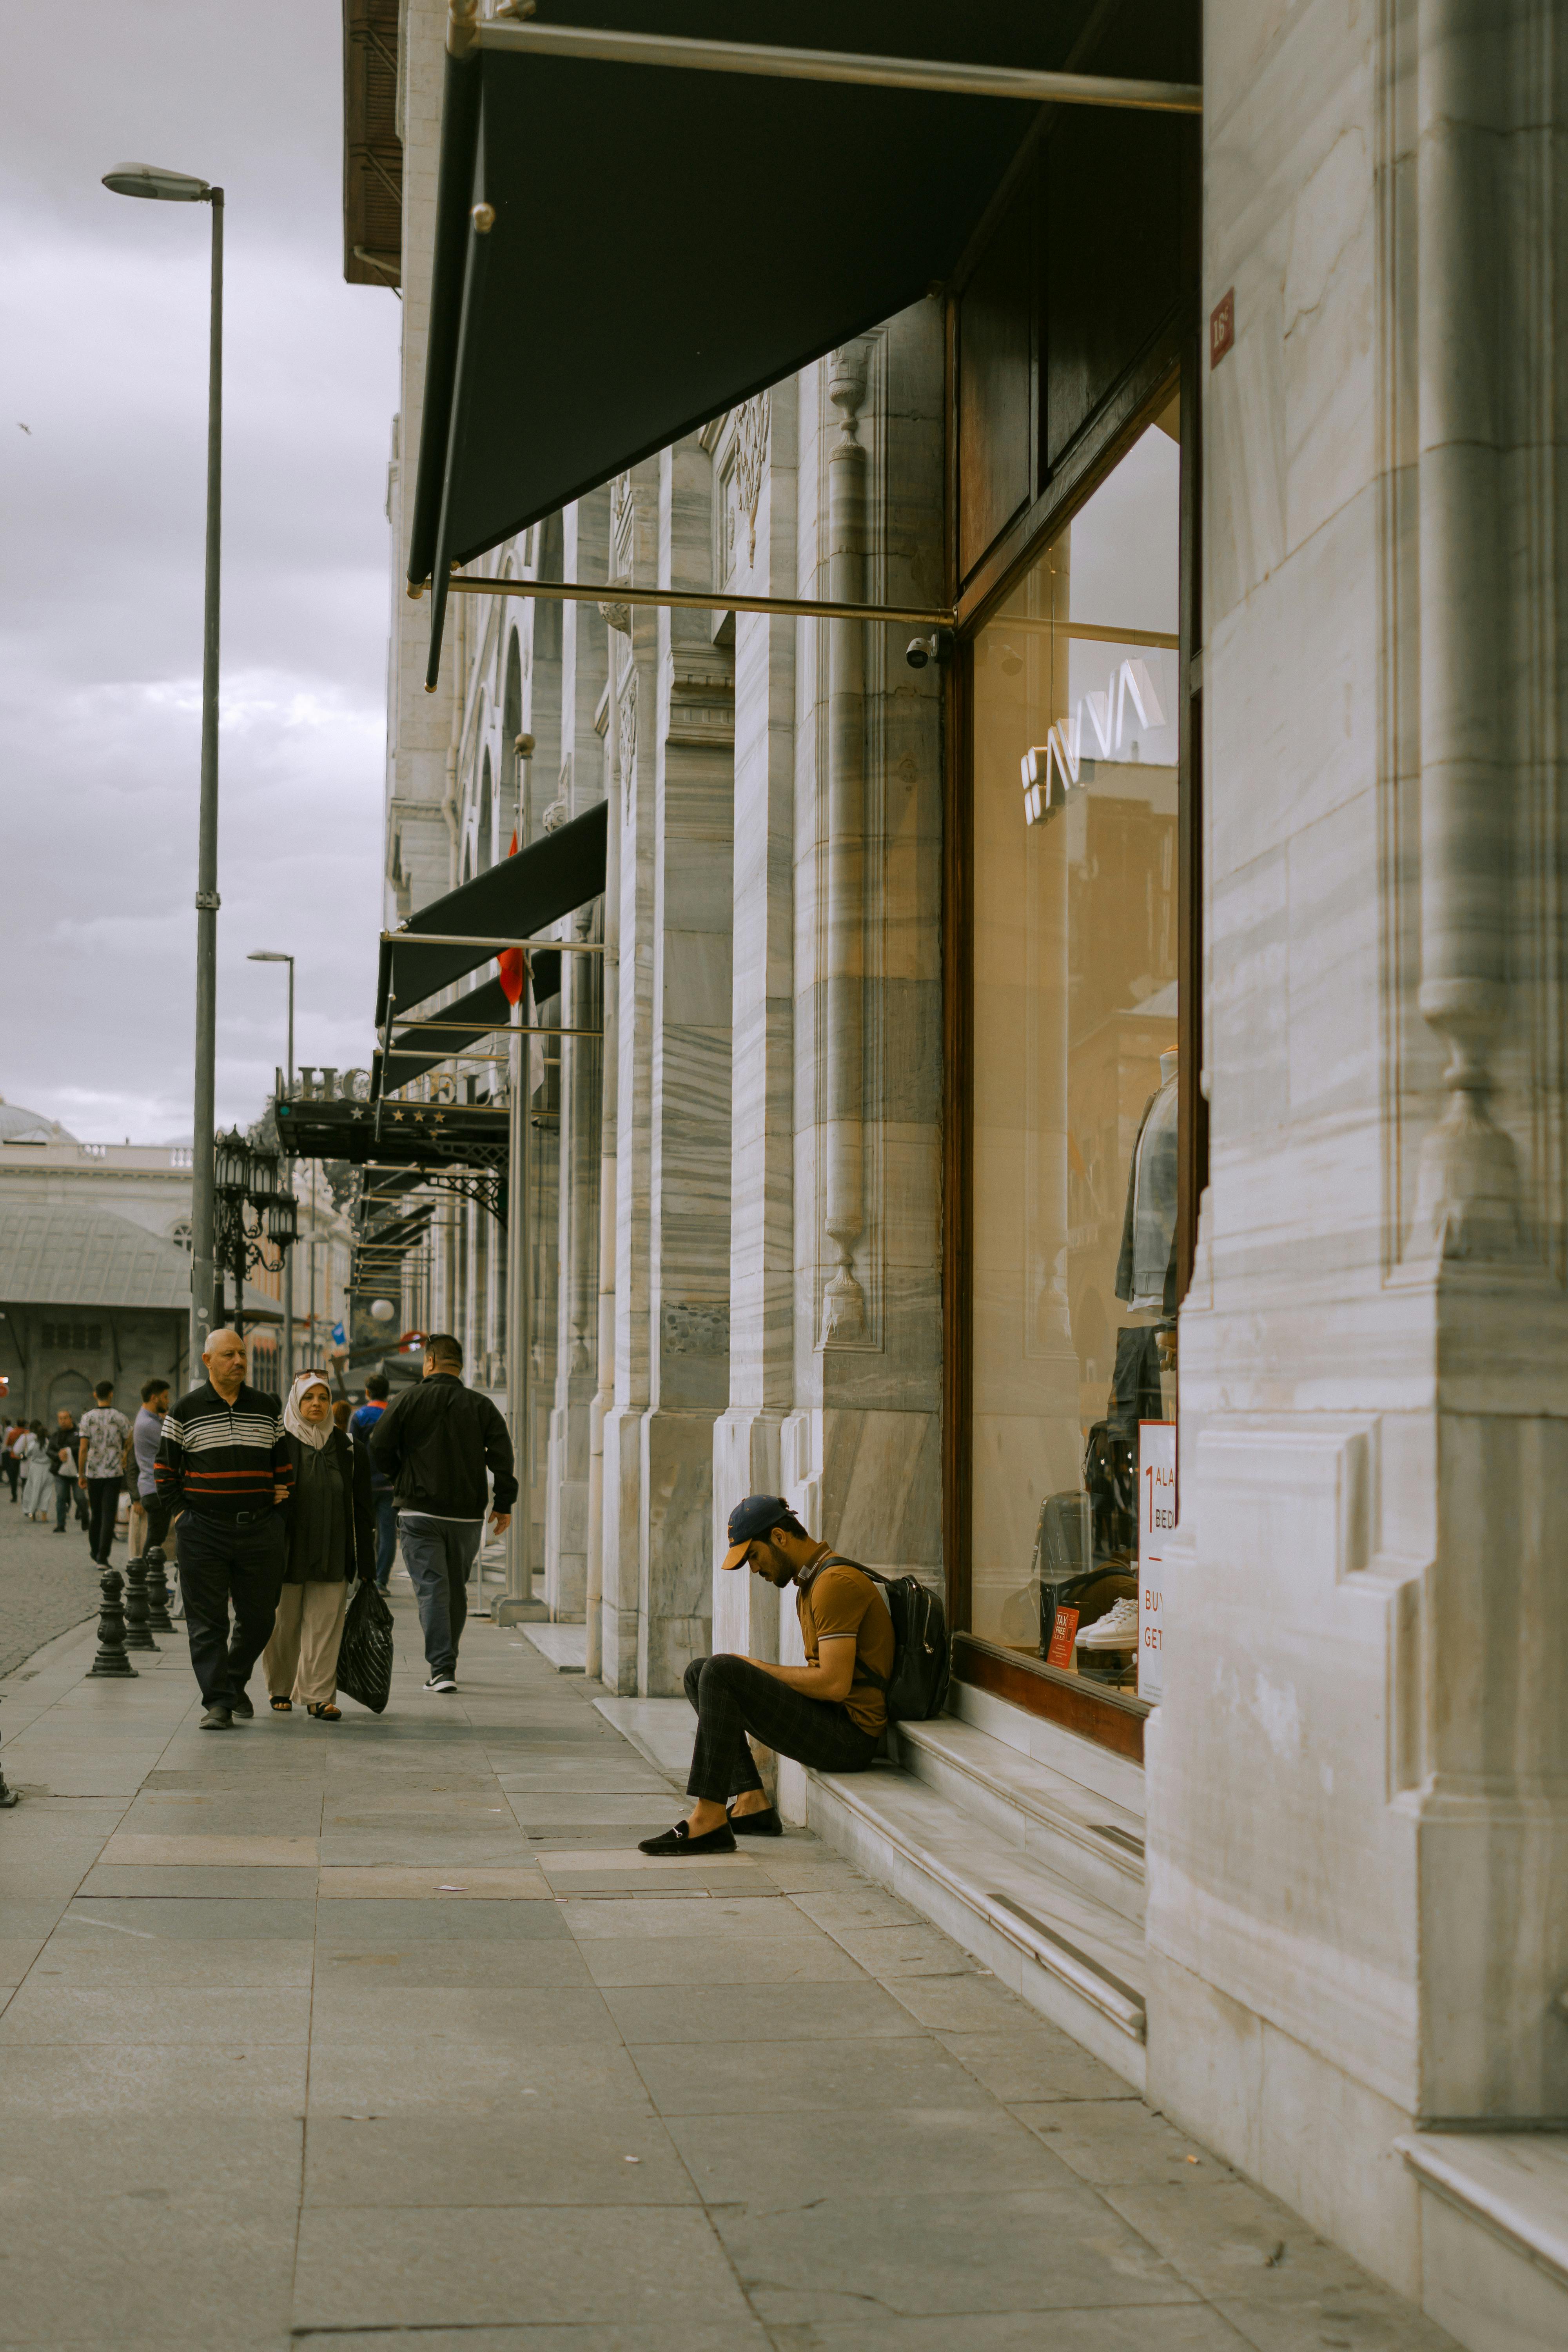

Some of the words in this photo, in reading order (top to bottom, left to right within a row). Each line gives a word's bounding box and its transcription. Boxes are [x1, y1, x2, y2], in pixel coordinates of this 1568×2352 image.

[298, 1067, 493, 1107] HOEL
[1146, 1465, 1153, 1533] 1
[1156, 1467, 1174, 1487] ALA
[1156, 1509, 1174, 1529] BED
[1055, 1626, 1065, 1635] FREE
[1057, 1614, 1067, 1627] TAX
[1145, 1626, 1163, 1650] GET
